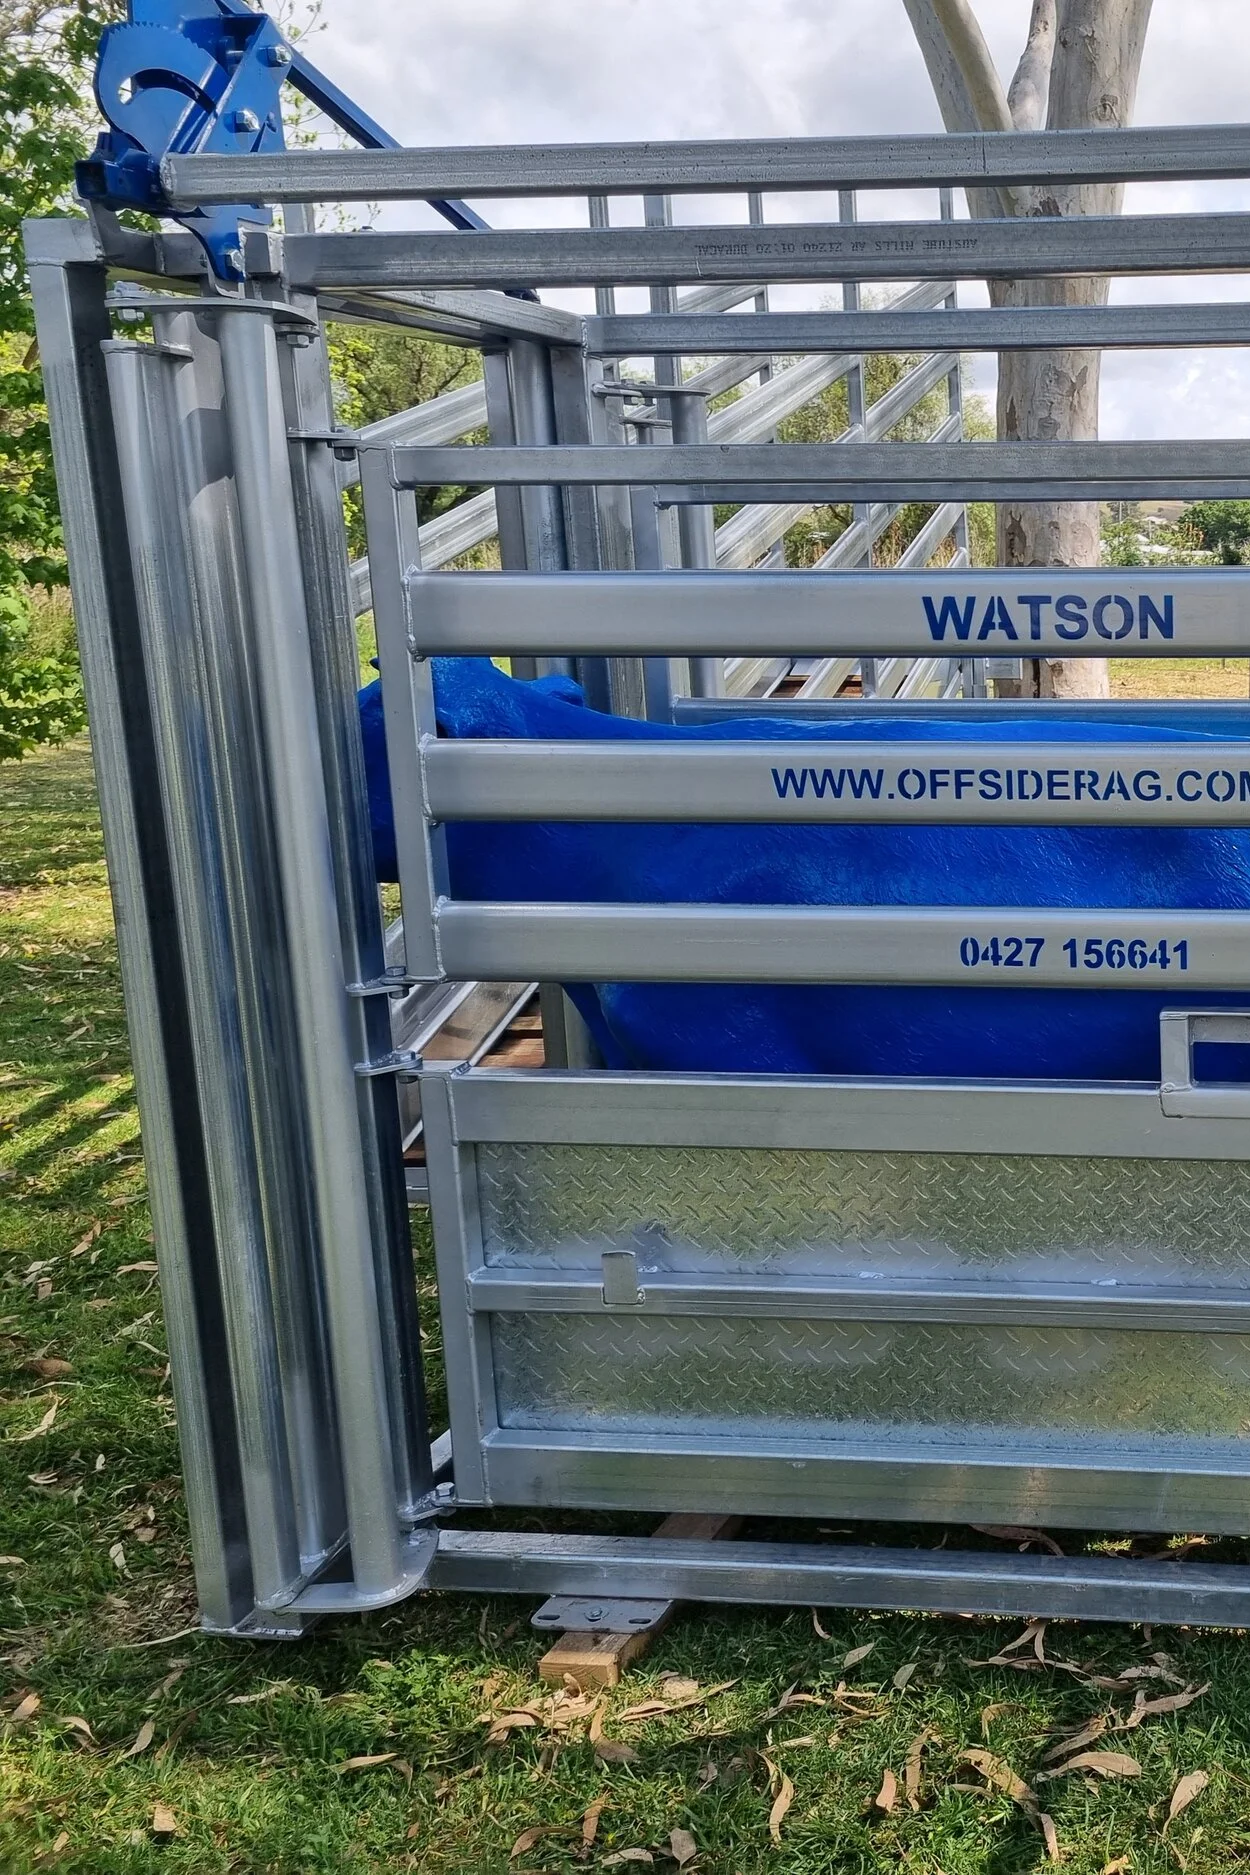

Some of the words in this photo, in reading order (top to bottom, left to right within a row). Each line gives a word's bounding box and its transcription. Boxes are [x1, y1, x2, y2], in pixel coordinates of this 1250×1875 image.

[874, 240, 914, 251] MILLS
[922, 239, 978, 251] AUSTUBE
[922, 595, 1174, 640] WATSON
[960, 937, 1045, 967] 0427
[1062, 938, 1188, 970] 156641
